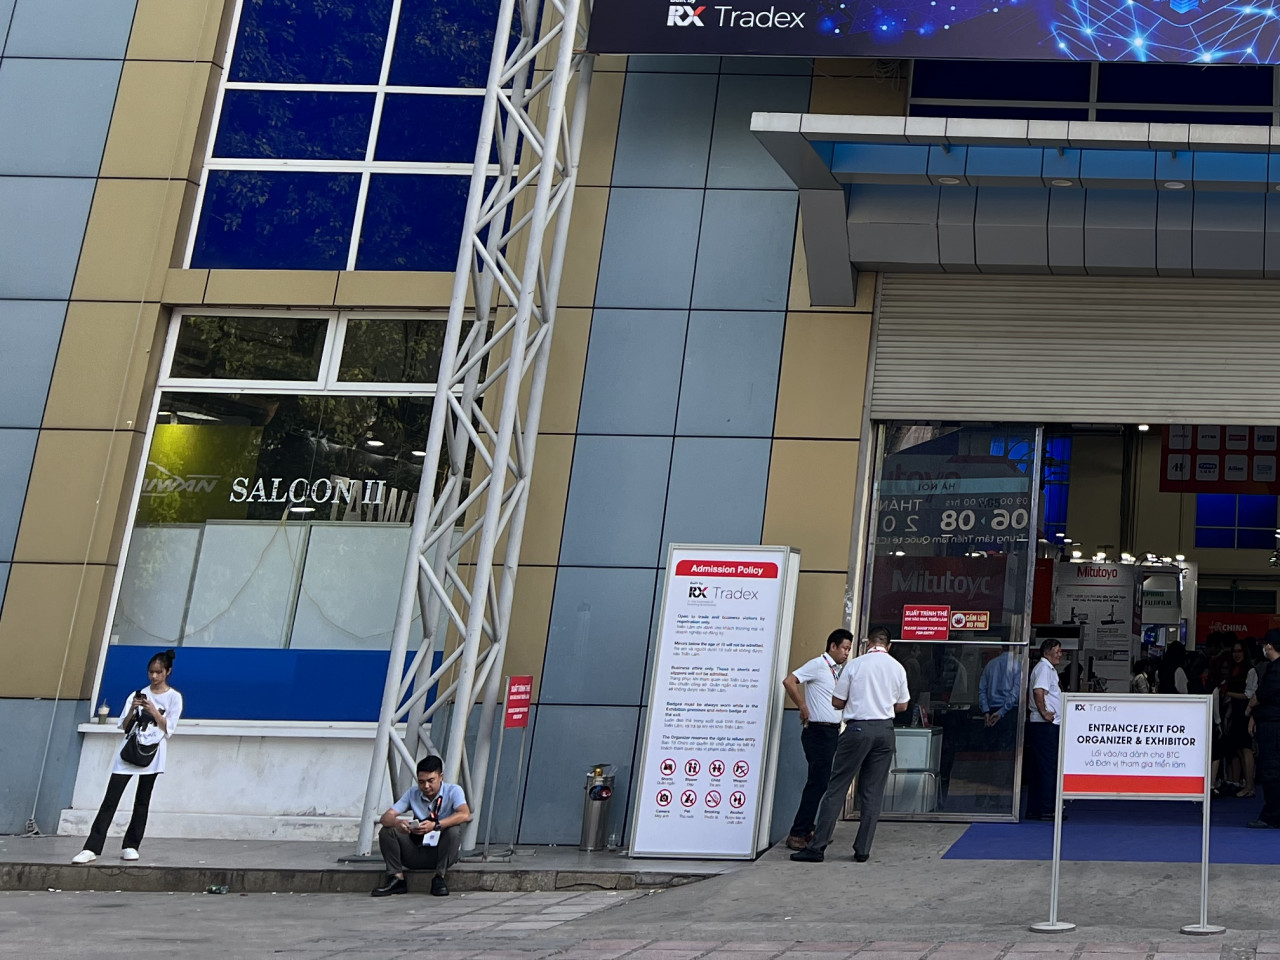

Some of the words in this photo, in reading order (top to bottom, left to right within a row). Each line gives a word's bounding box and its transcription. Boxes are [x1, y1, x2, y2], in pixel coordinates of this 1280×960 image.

[667, 6, 707, 26] RX
[714, 6, 806, 28] Tradex
[690, 564, 736, 574] Admission
[737, 565, 764, 576] Policy
[1077, 566, 1118, 580] Mitutoyo
[712, 586, 759, 600] Tradex
[1089, 704, 1117, 712] Tradex
[1088, 723, 1163, 734] ENTRANCE/EXIT
[1166, 725, 1186, 734] FOR
[1076, 735, 1133, 745] ORGANIZER
[1135, 736, 1143, 745] &
[1145, 737, 1196, 746] EXHIBITOR
